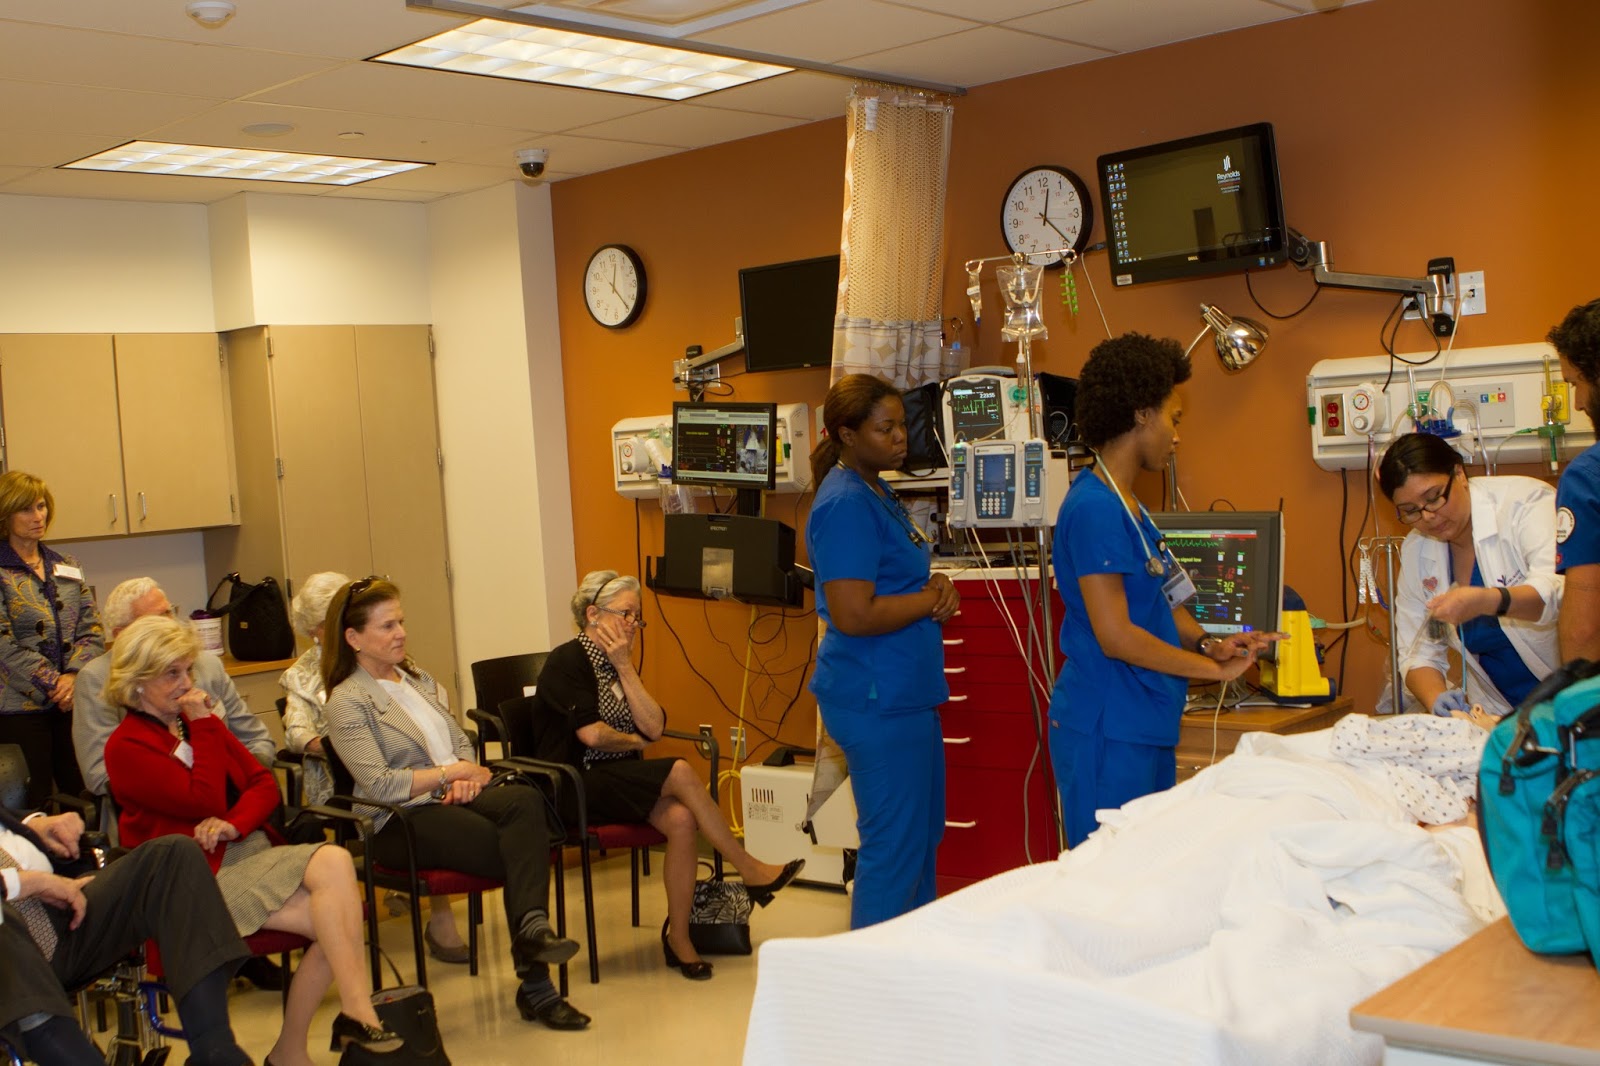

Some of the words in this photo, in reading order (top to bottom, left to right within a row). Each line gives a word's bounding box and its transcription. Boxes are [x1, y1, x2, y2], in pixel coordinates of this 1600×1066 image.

[1038, 177, 1048, 188] 12
[1024, 186, 1033, 196] 11
[1068, 192, 1074, 201] 2
[1014, 201, 1024, 210] 10
[1073, 208, 1079, 218] 3
[1012, 219, 1018, 228] 9
[1071, 226, 1077, 235] 4
[1019, 235, 1024, 244] 8
[1030, 245, 1036, 253] 7
[1062, 240, 1068, 249] 5
[609, 254, 616, 262] 12
[1045, 249, 1052, 259] 6
[629, 266, 633, 274] 2
